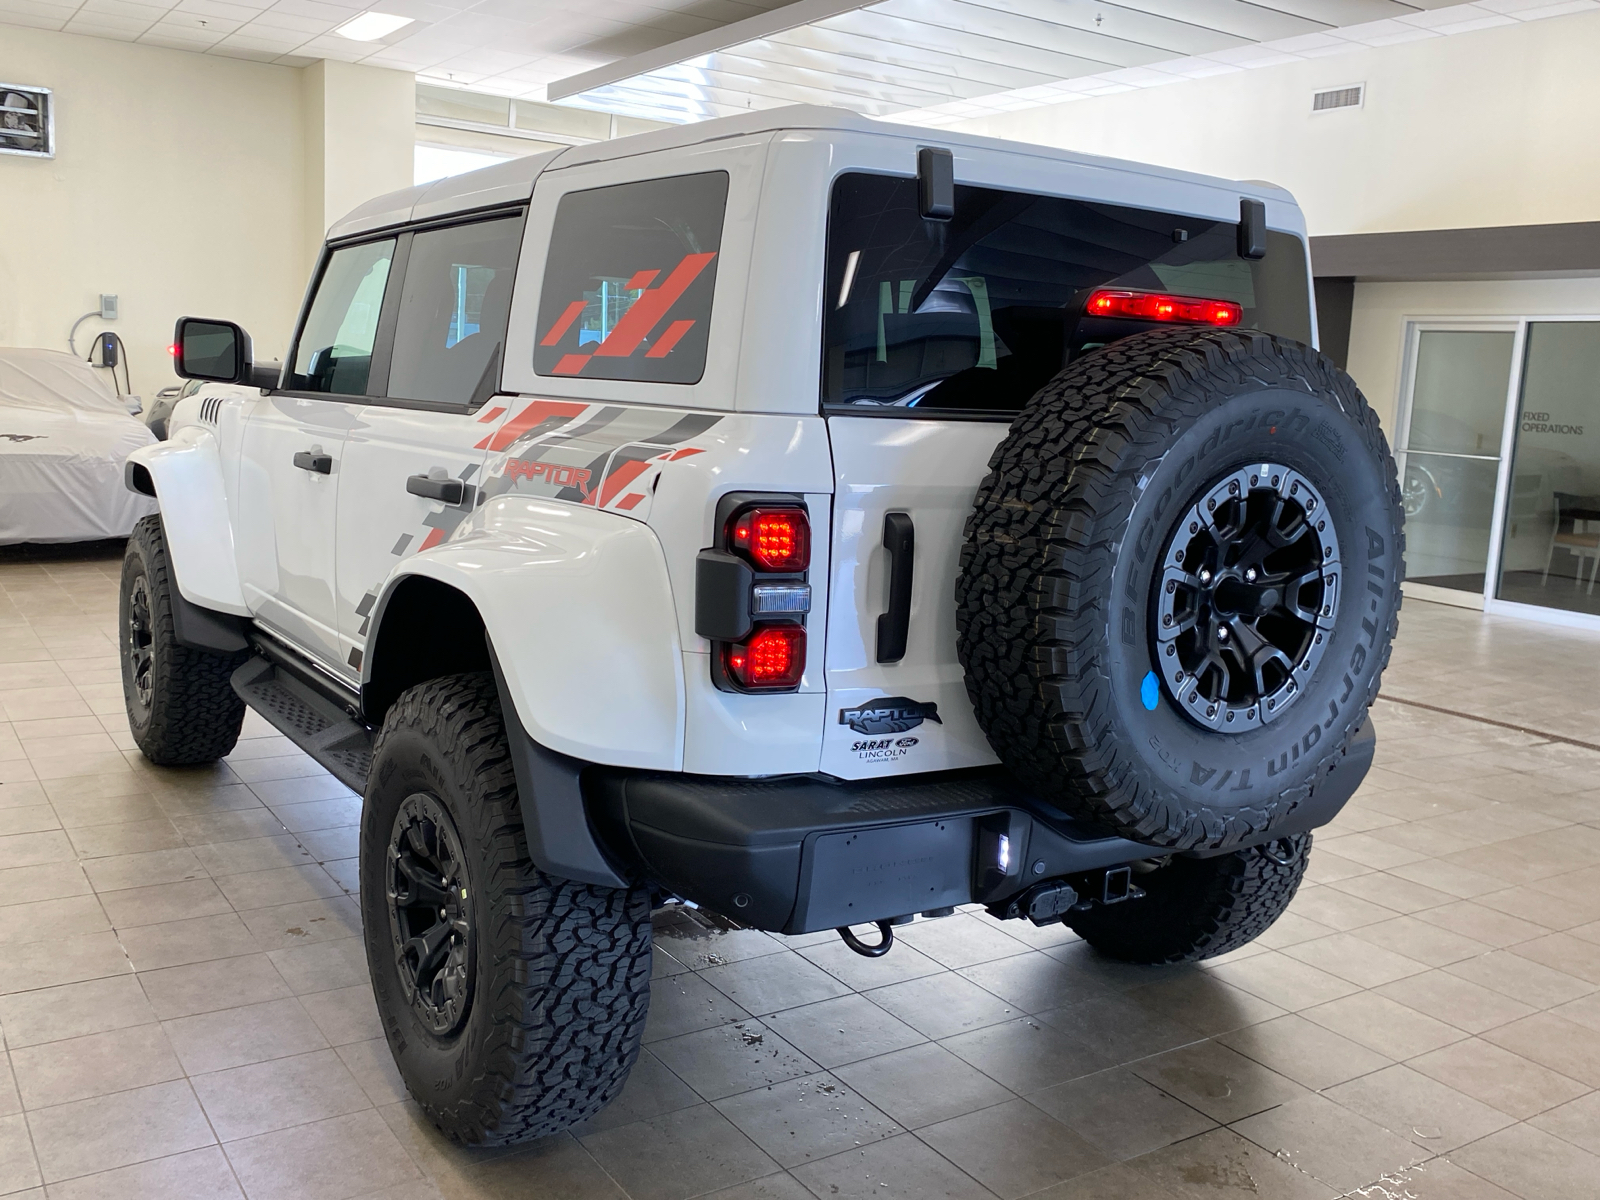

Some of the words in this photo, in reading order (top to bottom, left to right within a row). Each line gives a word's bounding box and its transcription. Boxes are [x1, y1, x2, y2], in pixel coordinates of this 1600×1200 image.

[1523, 411, 1550, 421] FIXED
[1522, 422, 1583, 435] OPERATIONS
[503, 457, 592, 502] RAPTOR
[1122, 407, 1310, 647] BFGoodrich
[843, 704, 943, 731] RAPTOR
[851, 738, 894, 750] SARAT
[859, 748, 907, 759] LINCOLN
